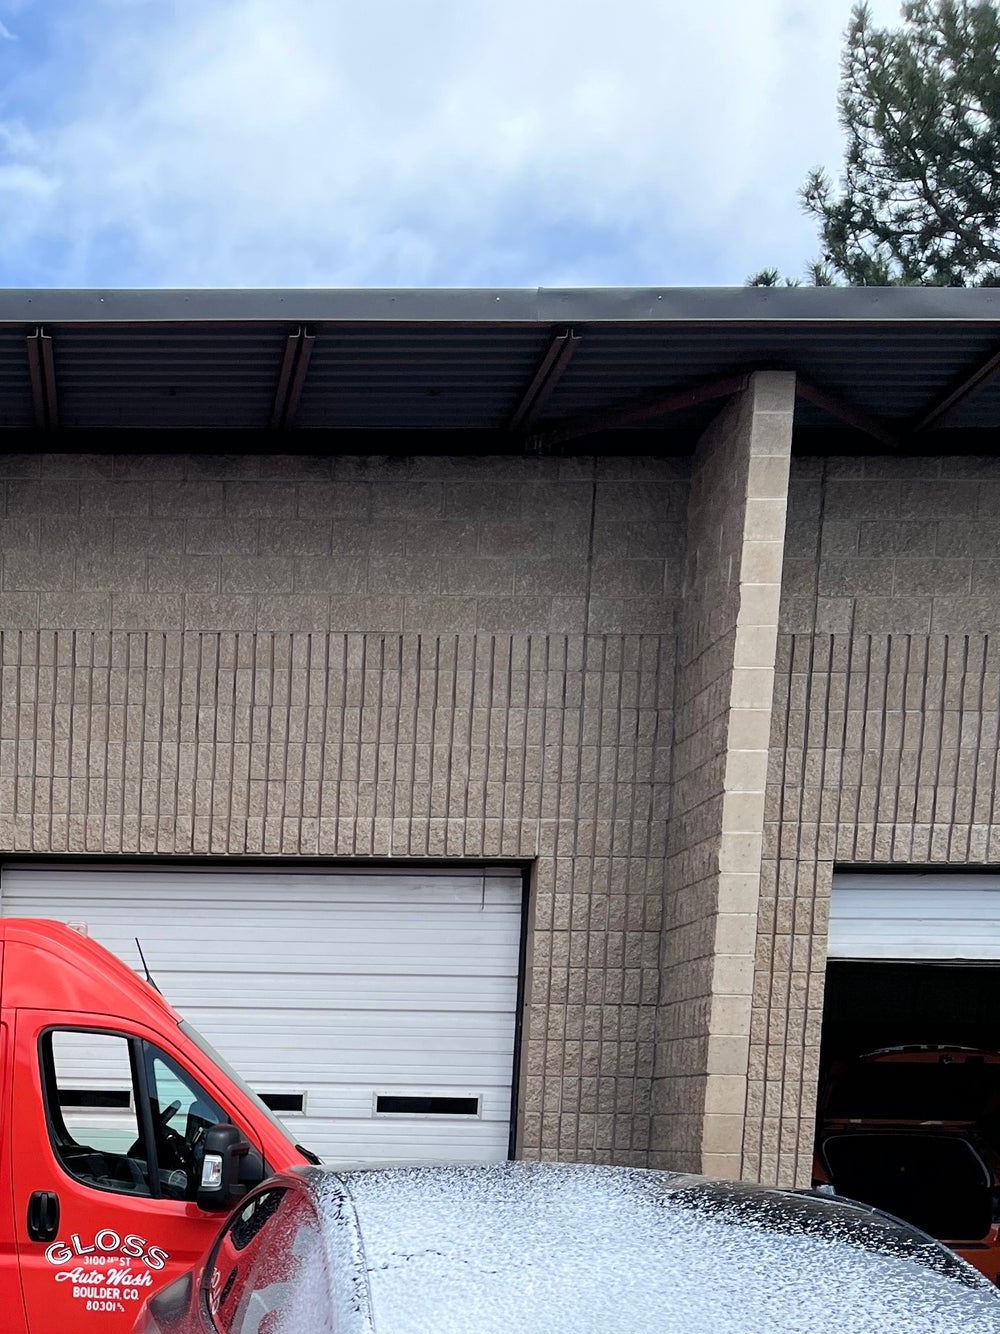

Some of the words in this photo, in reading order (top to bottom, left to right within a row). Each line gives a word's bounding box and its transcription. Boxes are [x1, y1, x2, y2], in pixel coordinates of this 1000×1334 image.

[45, 1228, 170, 1270] GLOSS
[83, 1255, 106, 1266] 3100
[120, 1257, 131, 1266] ST
[55, 1267, 106, 1284] Auto
[107, 1268, 153, 1286] Wash
[86, 1300, 116, 1311] 80301
